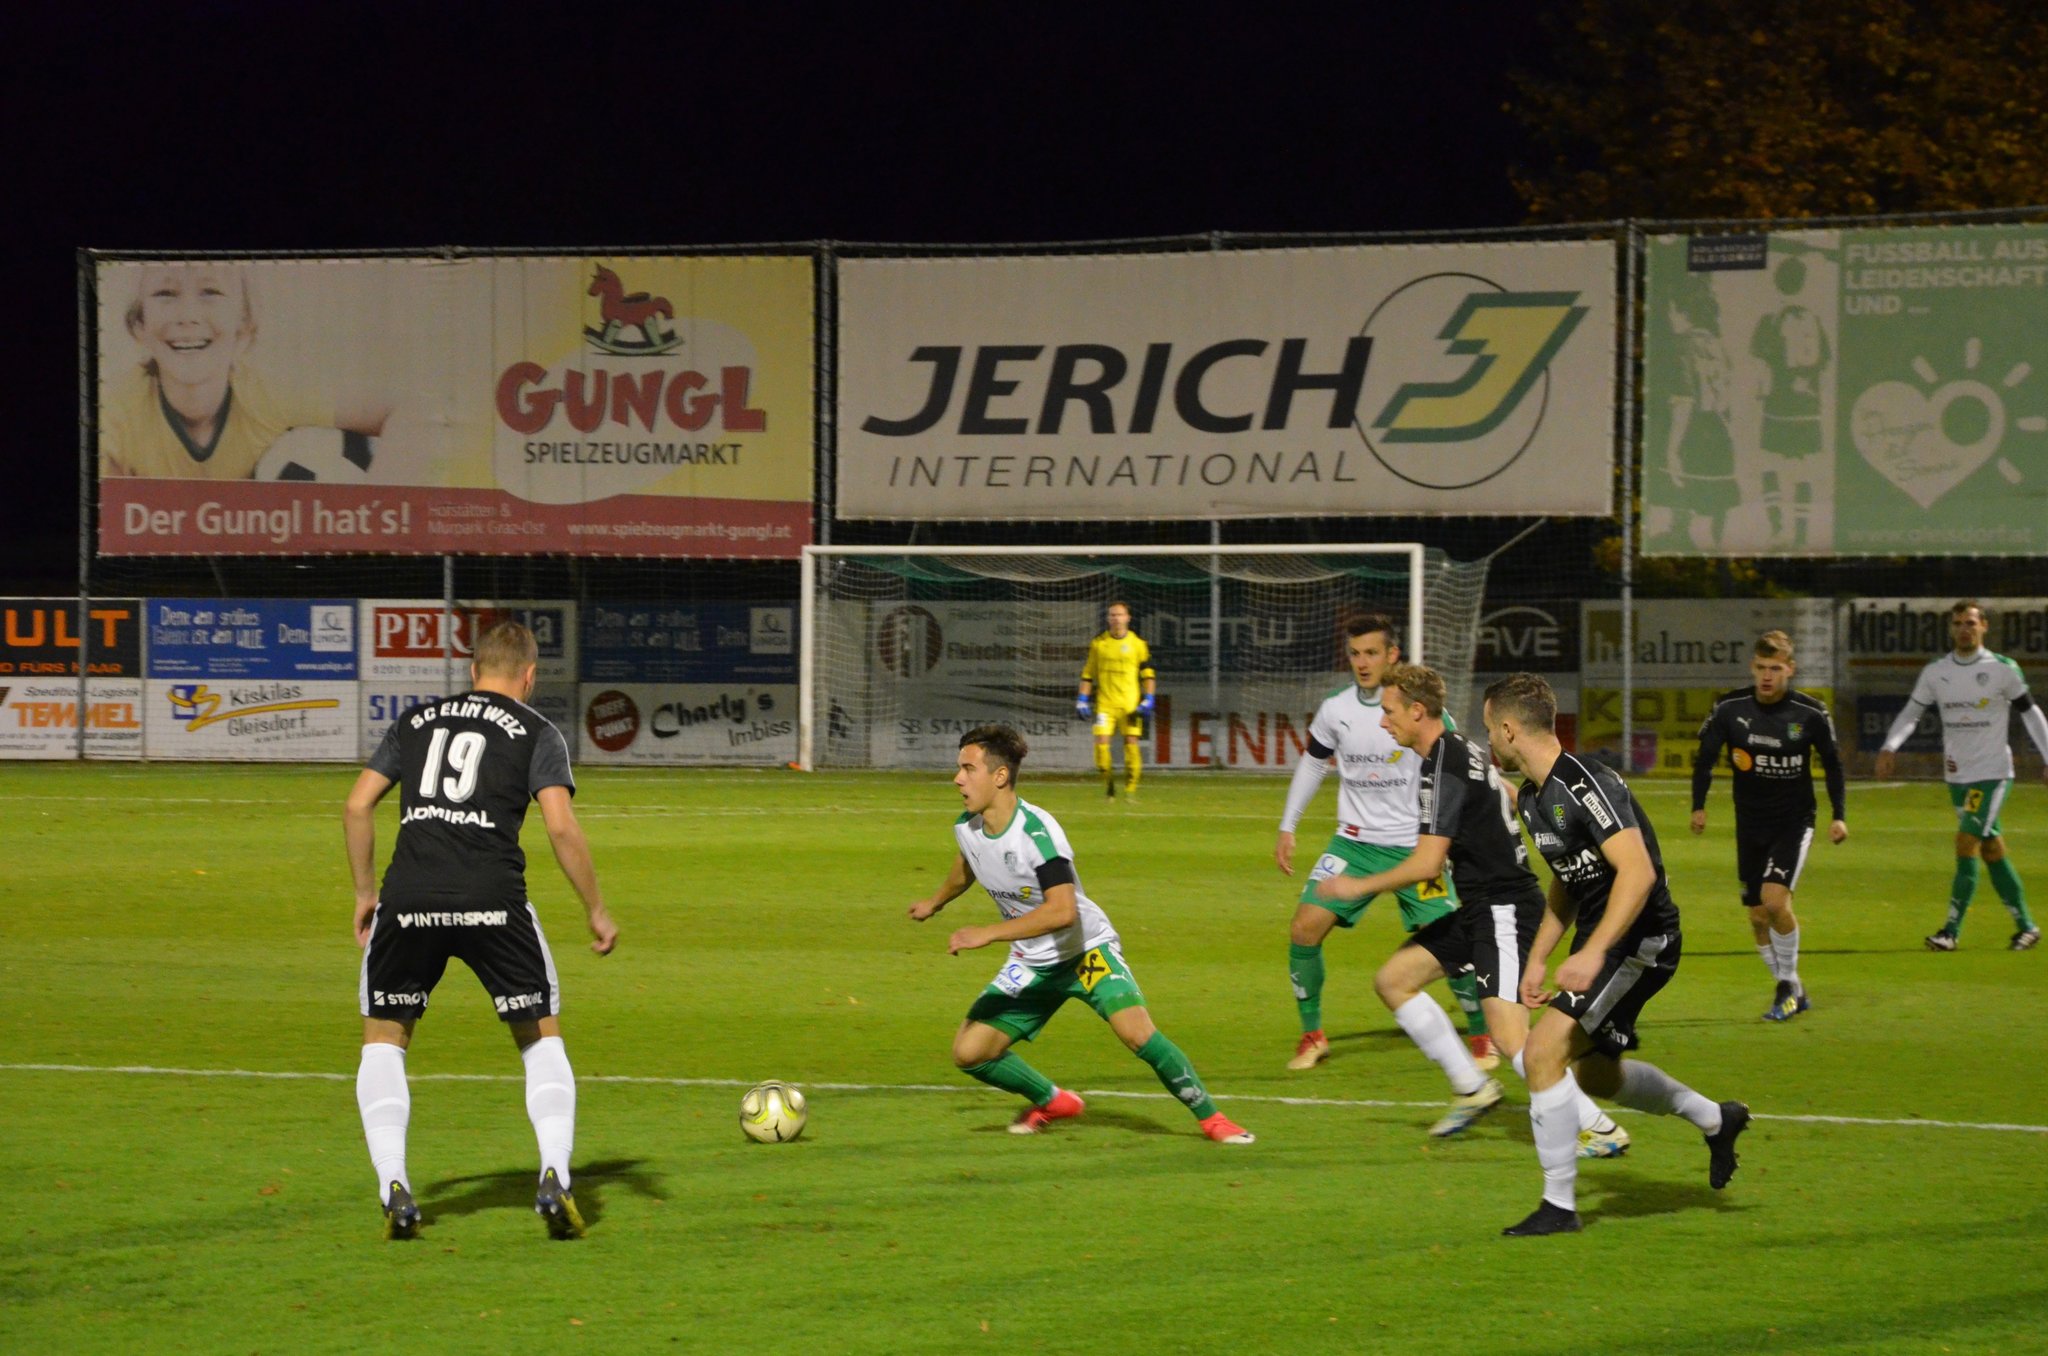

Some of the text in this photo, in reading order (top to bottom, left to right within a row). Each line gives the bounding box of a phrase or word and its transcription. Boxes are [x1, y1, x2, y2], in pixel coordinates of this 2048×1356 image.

[1846, 240, 1983, 264] FUSSBALL
[1846, 265, 2048, 290] LEIDENSCHAFT
[1846, 294, 1901, 316] UND
[495, 361, 767, 436] GUNGL
[861, 336, 1374, 438] JERICH
[524, 441, 743, 467] SPIELZEUGMARKT
[888, 450, 1357, 488] INTERNATIONAL
[124, 503, 187, 536] Der
[197, 500, 301, 543] Gungl
[229, 683, 304, 707] Kiskilas
[227, 711, 309, 738] Gleisdorf
[410, 705, 436, 730] SC
[439, 701, 483, 720] ELIN
[481, 704, 528, 741] WEIZ
[728, 719, 793, 747] Imbiss
[418, 726, 487, 804] 19
[1755, 753, 1804, 768] ELIN
[400, 805, 496, 829] ADMIRAL
[413, 910, 508, 928] INTERSPORT
